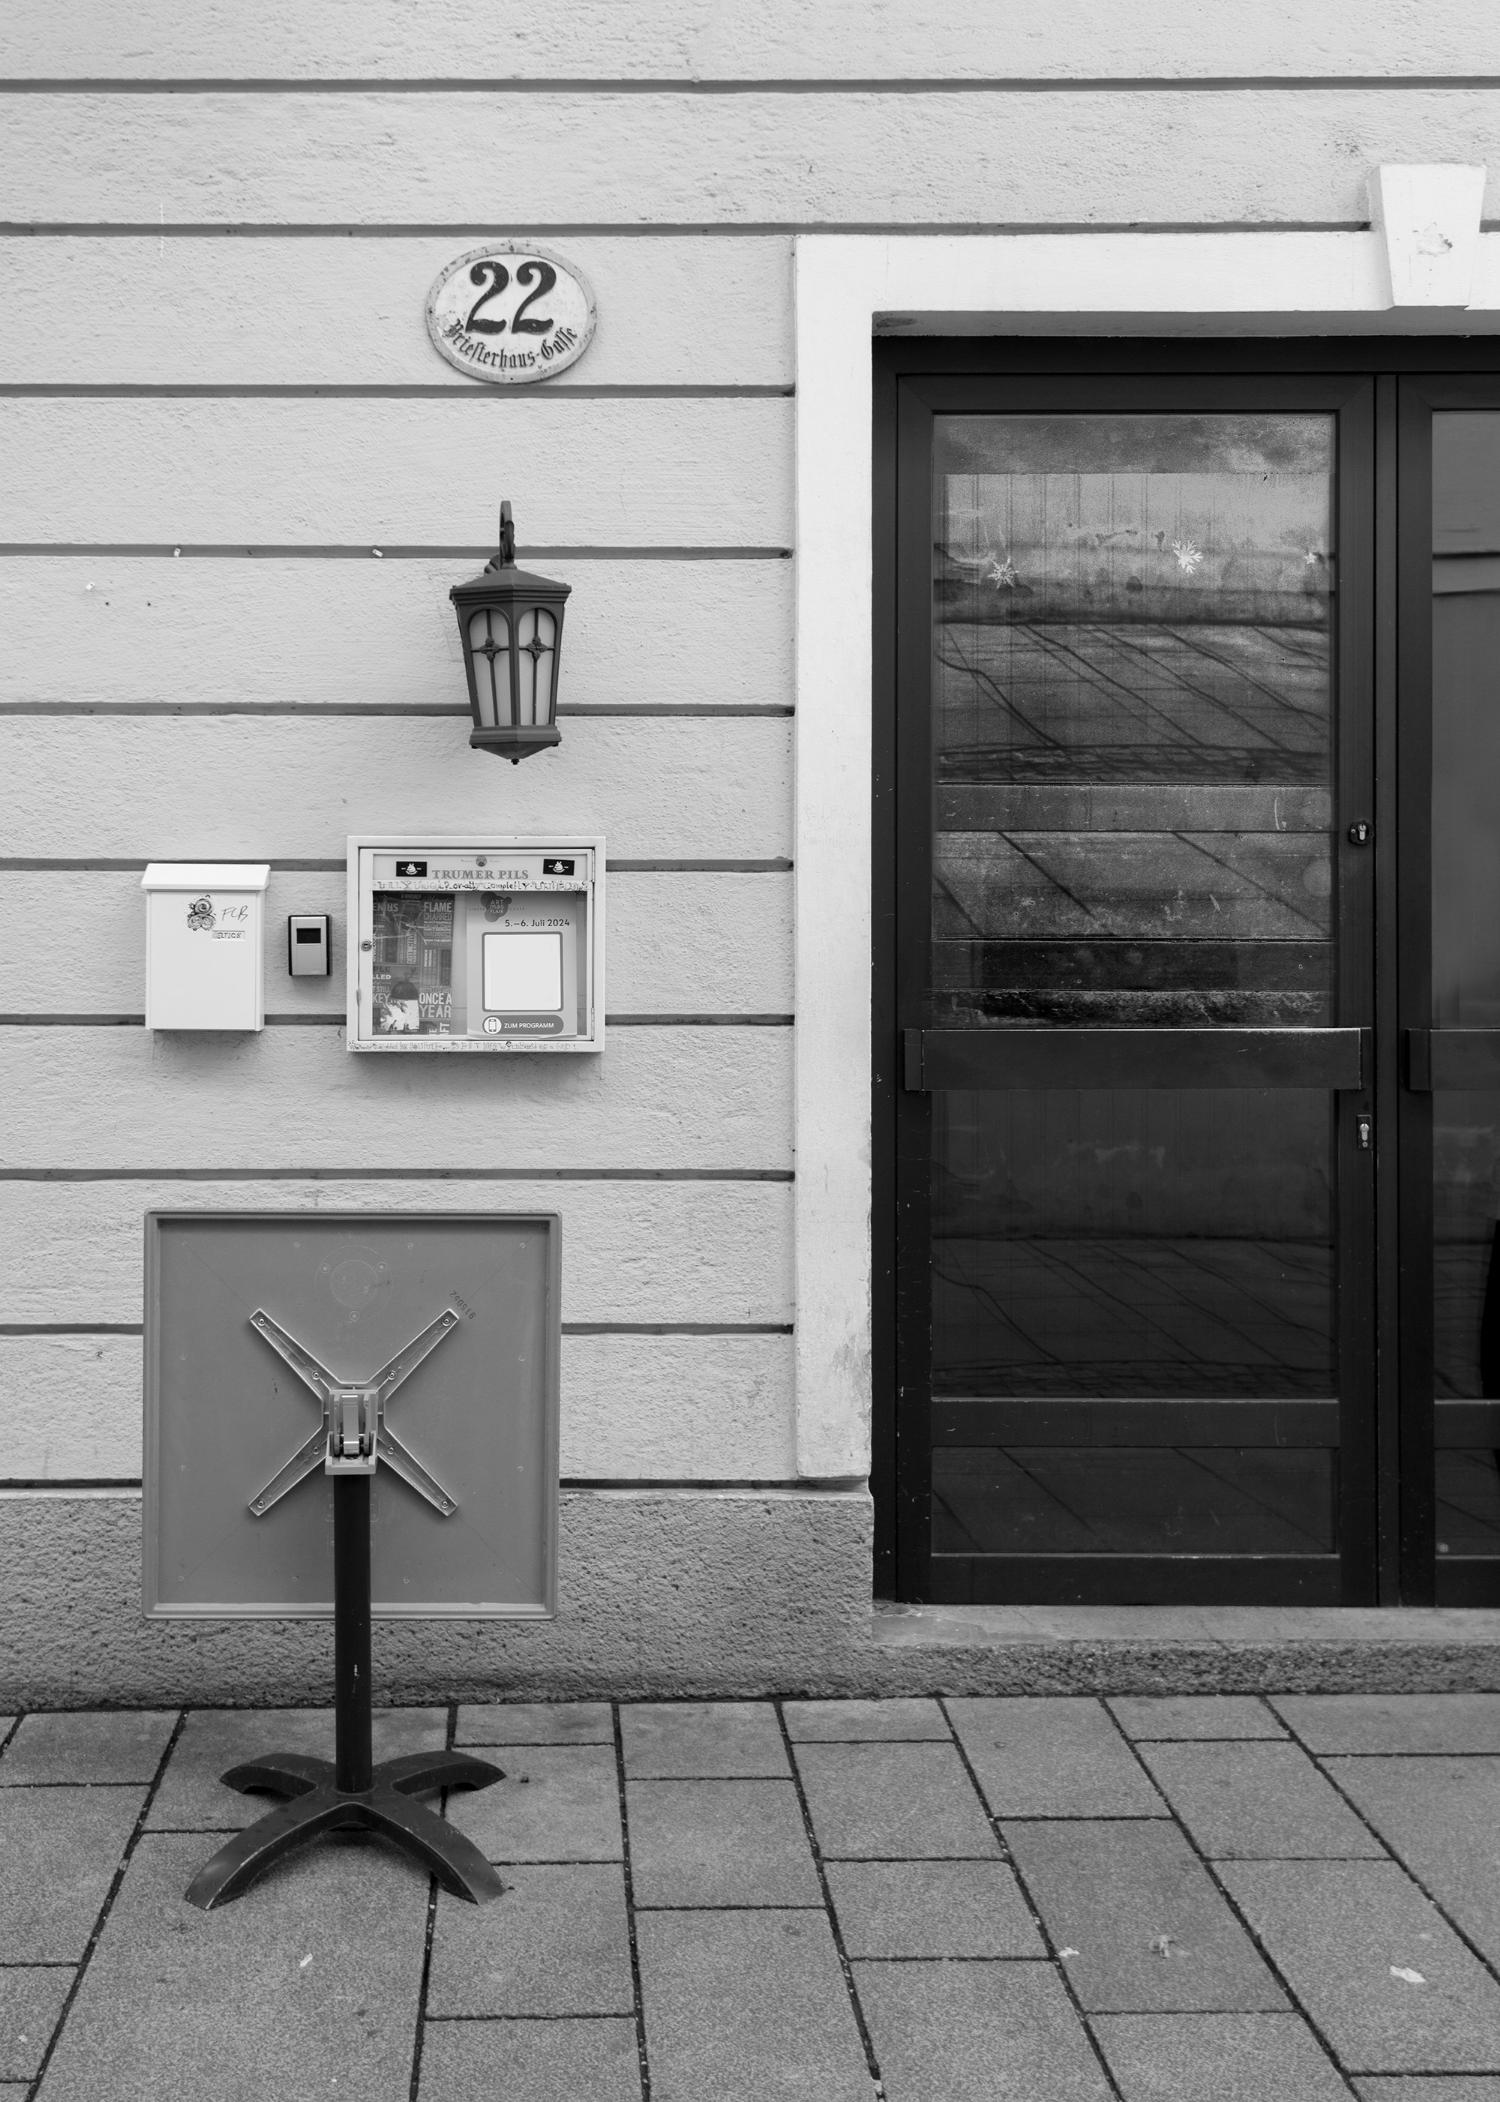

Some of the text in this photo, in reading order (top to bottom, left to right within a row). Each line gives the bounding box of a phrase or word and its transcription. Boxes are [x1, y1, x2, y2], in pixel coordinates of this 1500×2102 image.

[465, 260, 557, 335] 22
[432, 869, 529, 879] TRUMER PILS
[423, 902, 452, 913] FLAME
[531, 919, 545, 927] Juli
[547, 919, 570, 927] 2024
[419, 992, 452, 1005] ONCE A
[420, 1005, 452, 1018] YEAR
